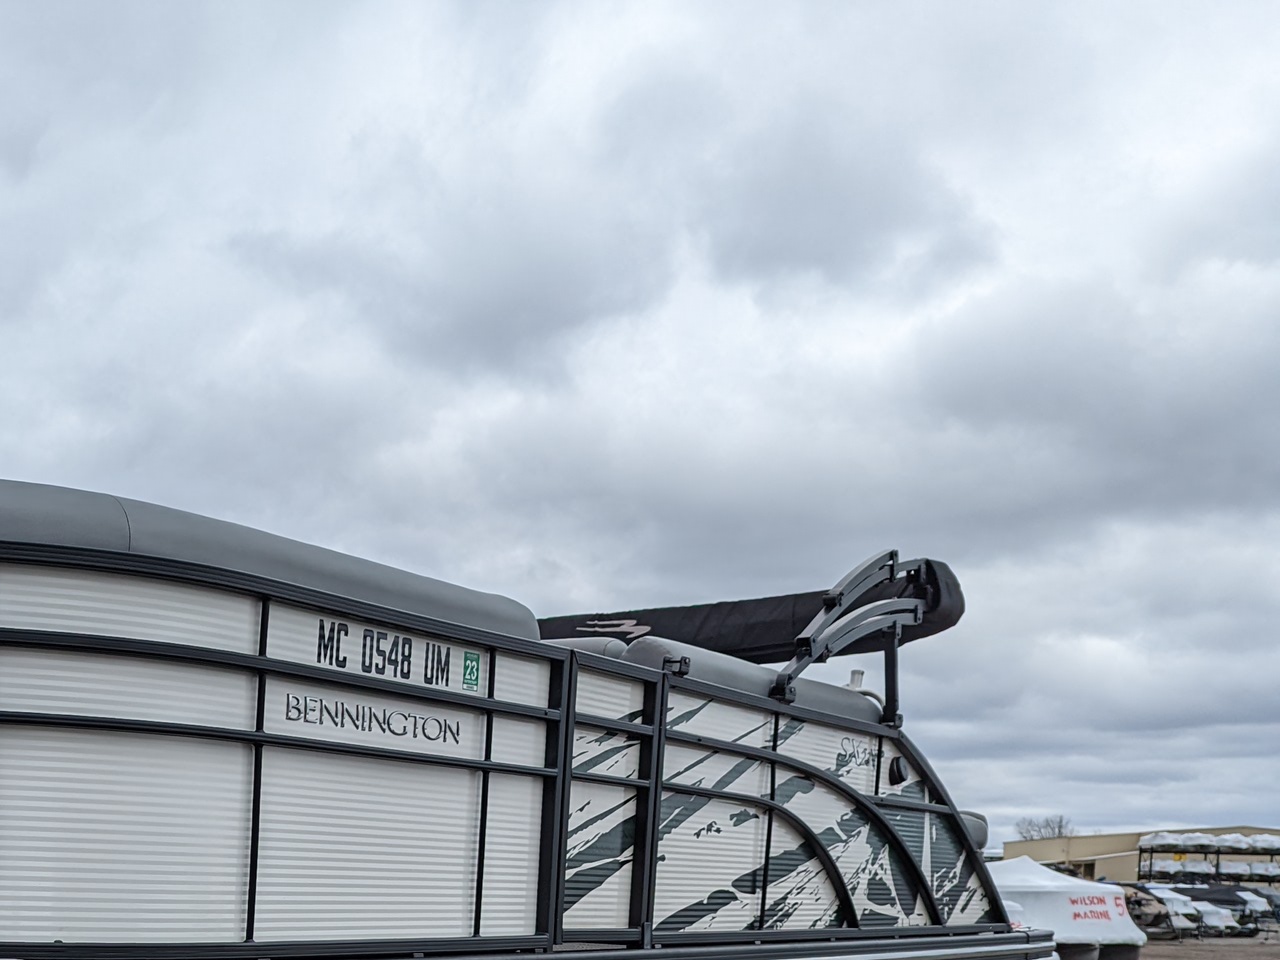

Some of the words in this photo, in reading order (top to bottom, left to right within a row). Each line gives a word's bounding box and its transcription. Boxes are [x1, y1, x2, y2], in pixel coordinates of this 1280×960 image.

[317, 619, 348, 668] MC
[361, 629, 412, 680] 0548
[424, 642, 451, 687] UM
[465, 659, 478, 681] 23
[285, 693, 460, 745] BENNINGTON
[1068, 896, 1107, 906] WILSON
[1072, 909, 1112, 922] MARINE
